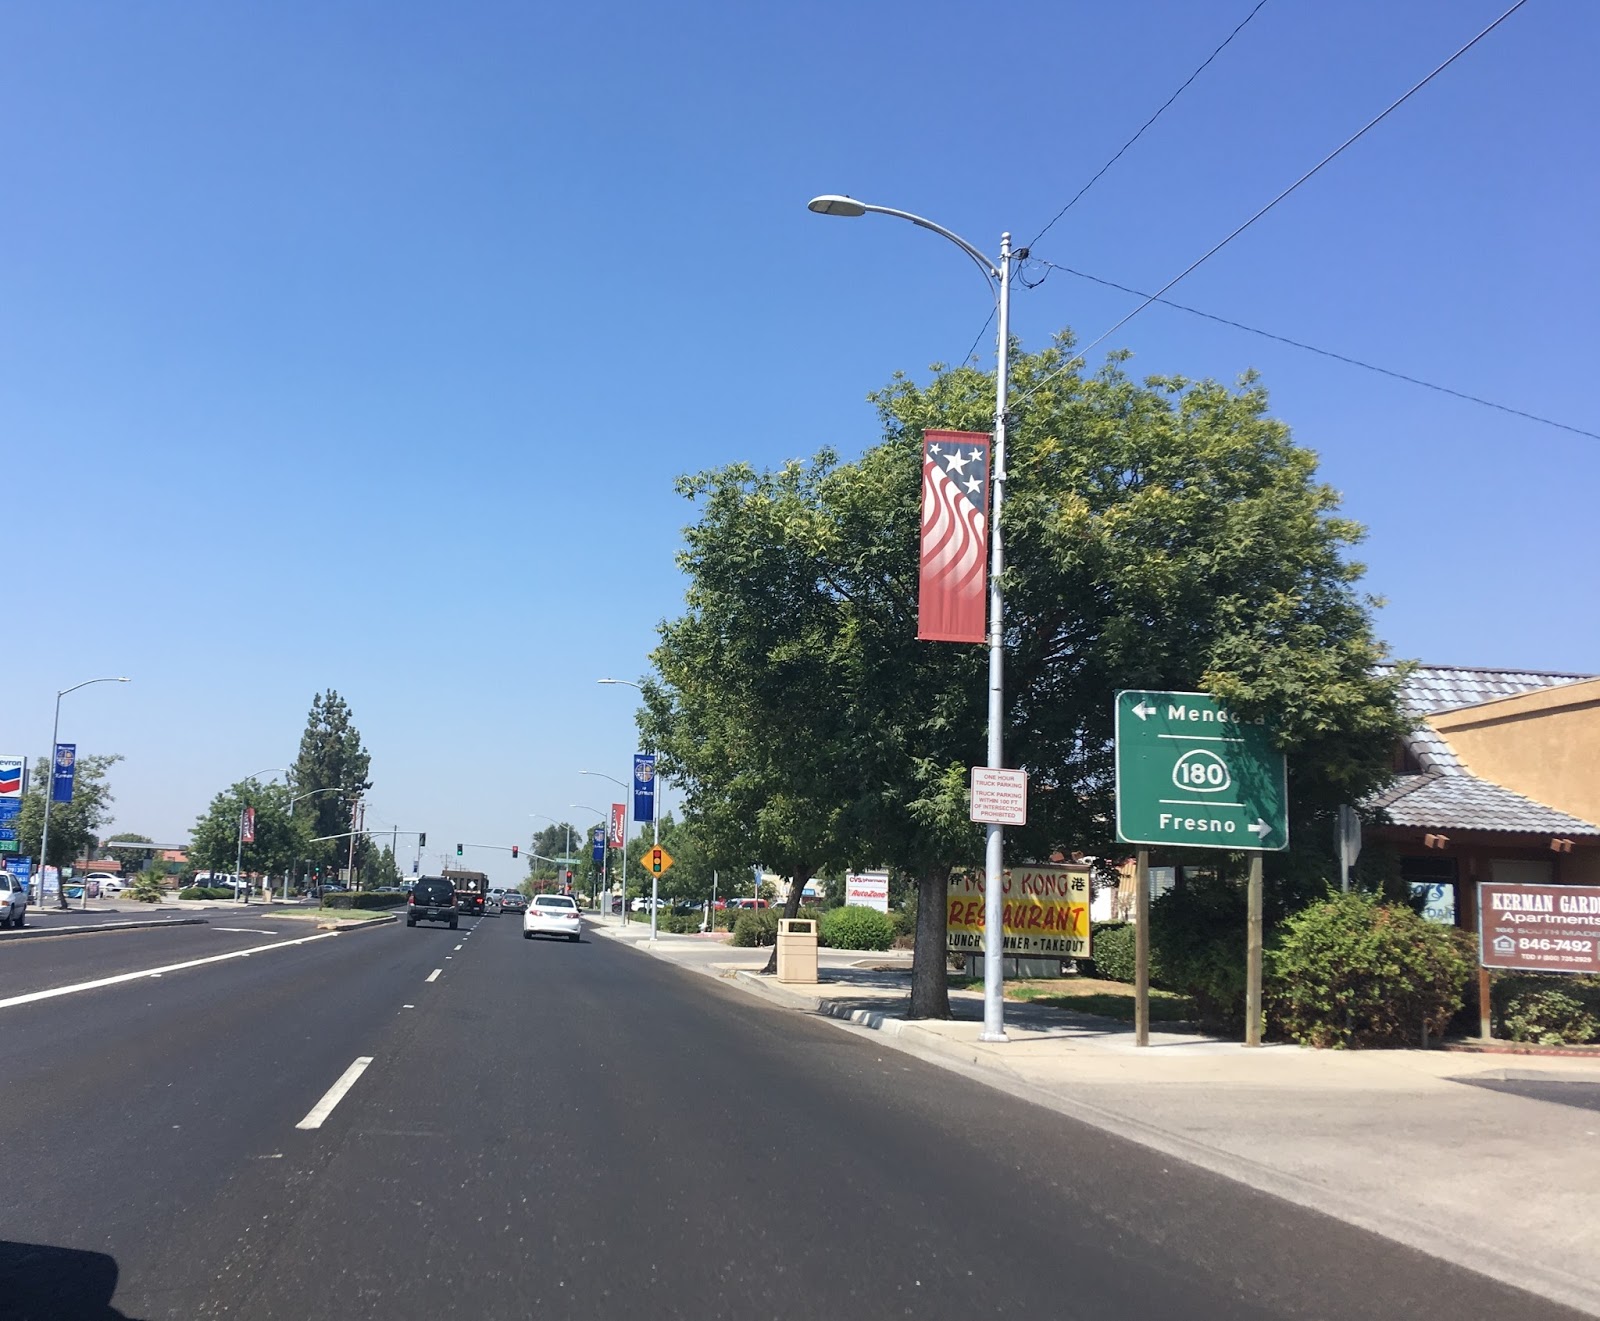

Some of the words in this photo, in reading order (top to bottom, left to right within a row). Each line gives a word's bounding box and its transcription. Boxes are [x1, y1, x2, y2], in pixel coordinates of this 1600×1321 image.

[1168, 704, 1265, 725] Mendoa
[1181, 763, 1224, 785] 180
[1159, 813, 1236, 833] Fresno
[851, 890, 886, 898] AutoZone
[1021, 873, 1068, 897] KONG
[1492, 893, 1553, 912] KERMAN
[1560, 895, 1600, 914] GARD
[949, 900, 1085, 932] RESAURANT
[1501, 911, 1600, 925] Apartments
[1517, 928, 1560, 936] SOUTH
[949, 934, 981, 947] LUNCH
[999, 936, 1030, 950] NNER
[1040, 938, 1085, 953] TAKEOUT
[1519, 938, 1593, 953] 846-7492
